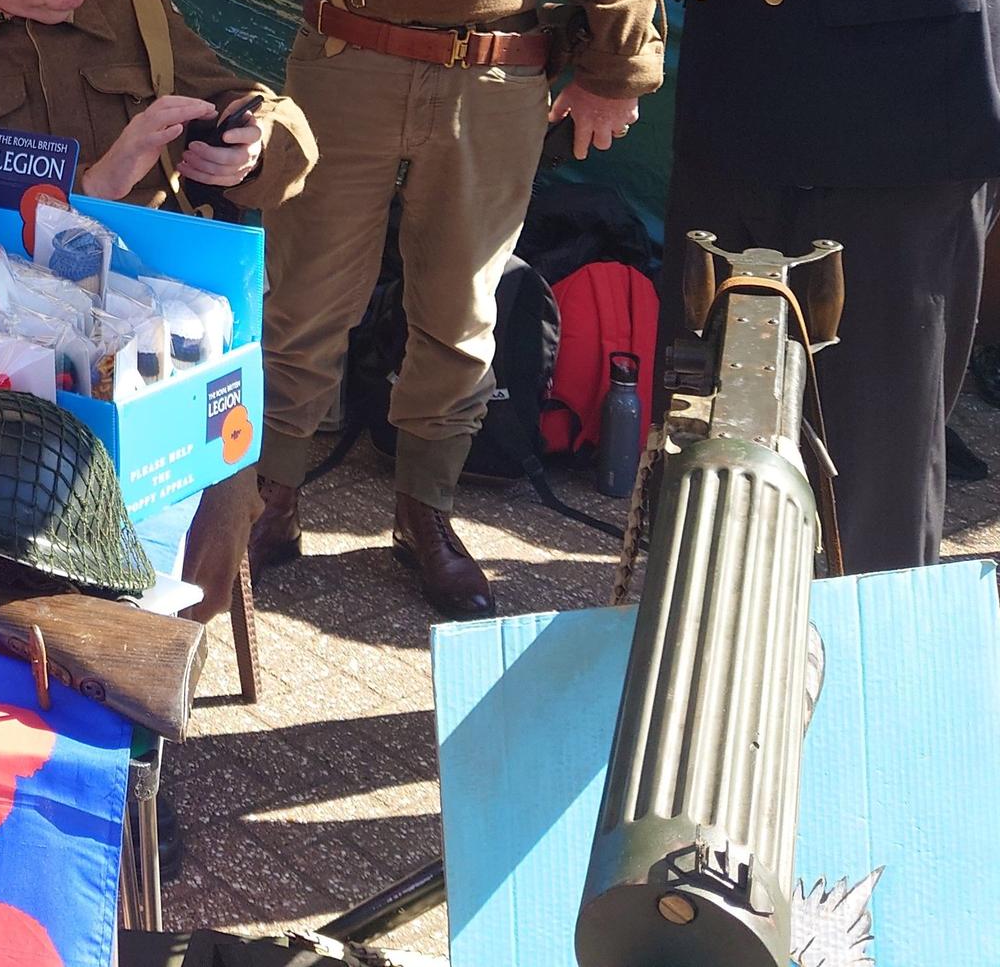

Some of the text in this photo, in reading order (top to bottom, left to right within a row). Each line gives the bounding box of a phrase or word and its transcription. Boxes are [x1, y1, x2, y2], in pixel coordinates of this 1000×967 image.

[13, 137, 36, 149] ROYAL
[38, 140, 68, 153] BRITISH
[208, 389, 241, 418] LEGION
[129, 443, 194, 483] PLEASE HELP
[151, 470, 171, 486] THE
[160, 474, 194, 499] APPEAL
